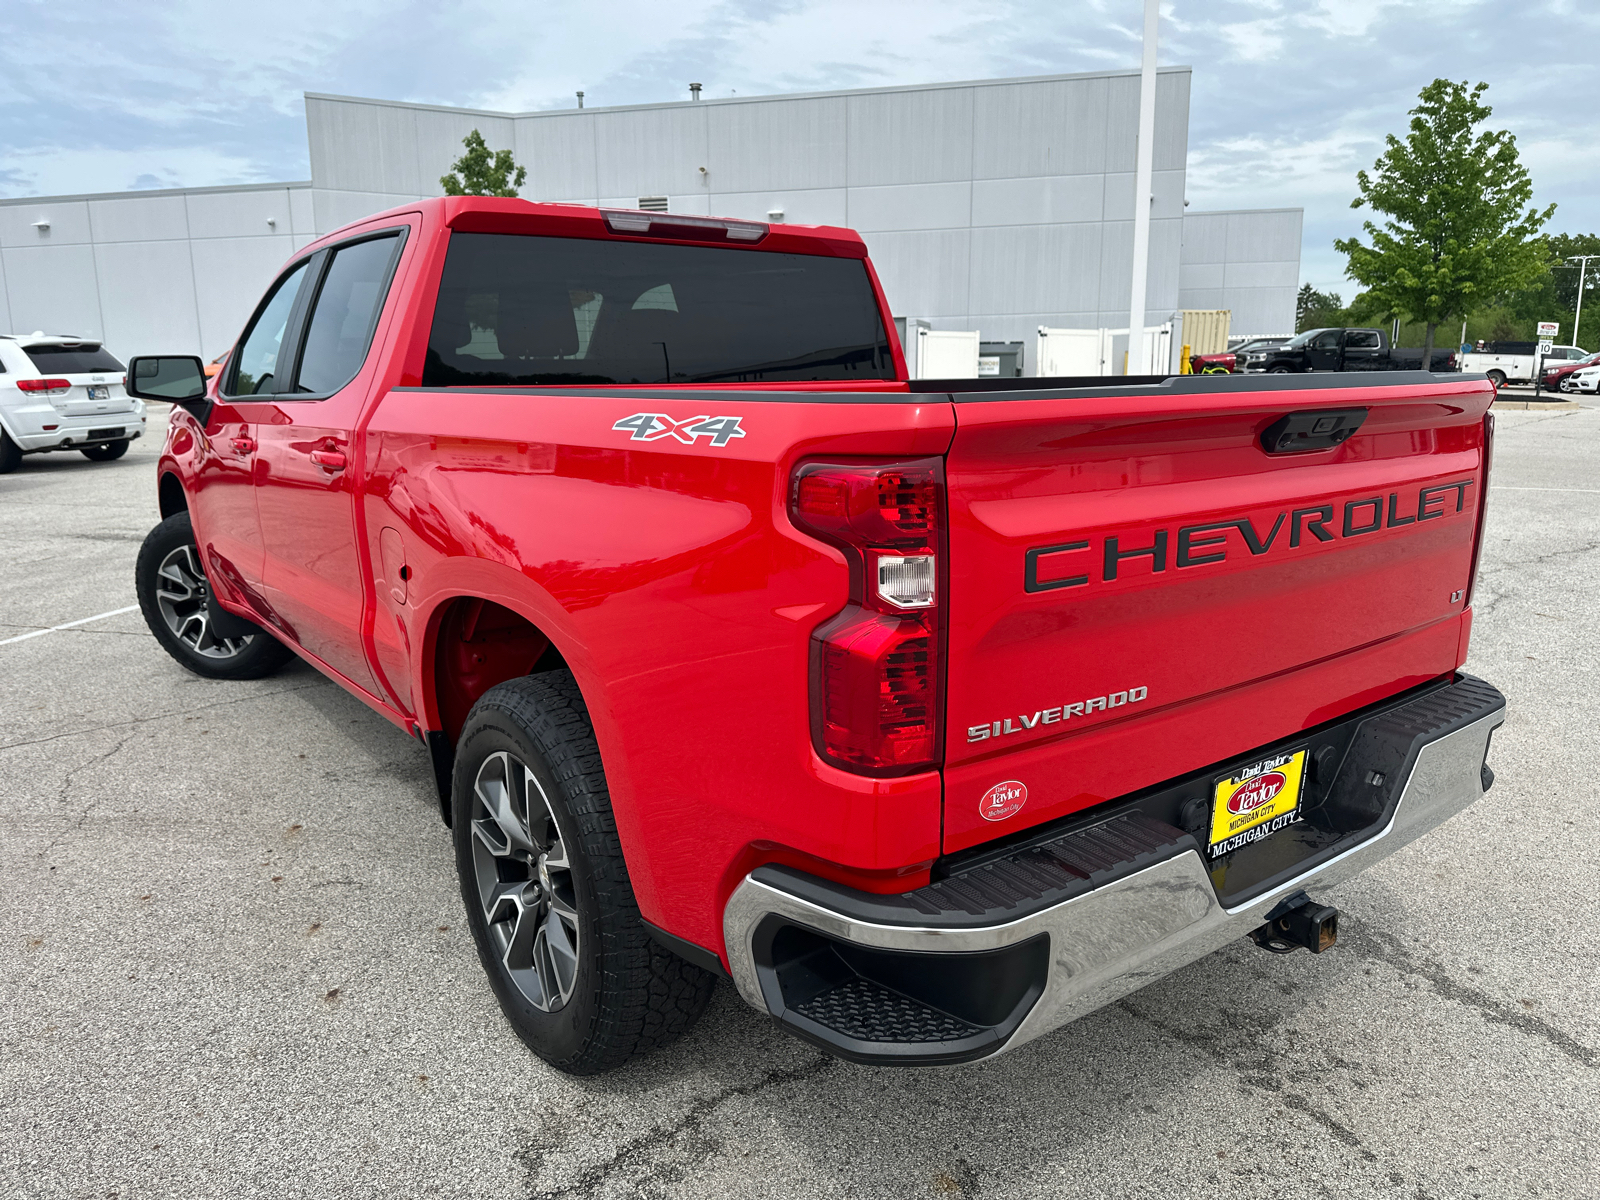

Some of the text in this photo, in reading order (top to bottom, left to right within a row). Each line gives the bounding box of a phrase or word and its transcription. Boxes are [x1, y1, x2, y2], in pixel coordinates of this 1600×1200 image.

[1024, 480, 1474, 593] CHEVROLET
[1450, 589, 1465, 604] LT
[967, 685, 1148, 743] SILVERADO
[1241, 755, 1287, 780] David Taylor
[990, 788, 1022, 805] Taylor
[1237, 782, 1280, 811] Taylor
[1245, 778, 1262, 792] David
[1229, 803, 1276, 832] MICHIGAN CITY
[1212, 810, 1297, 858] MICHIGAN CITY
